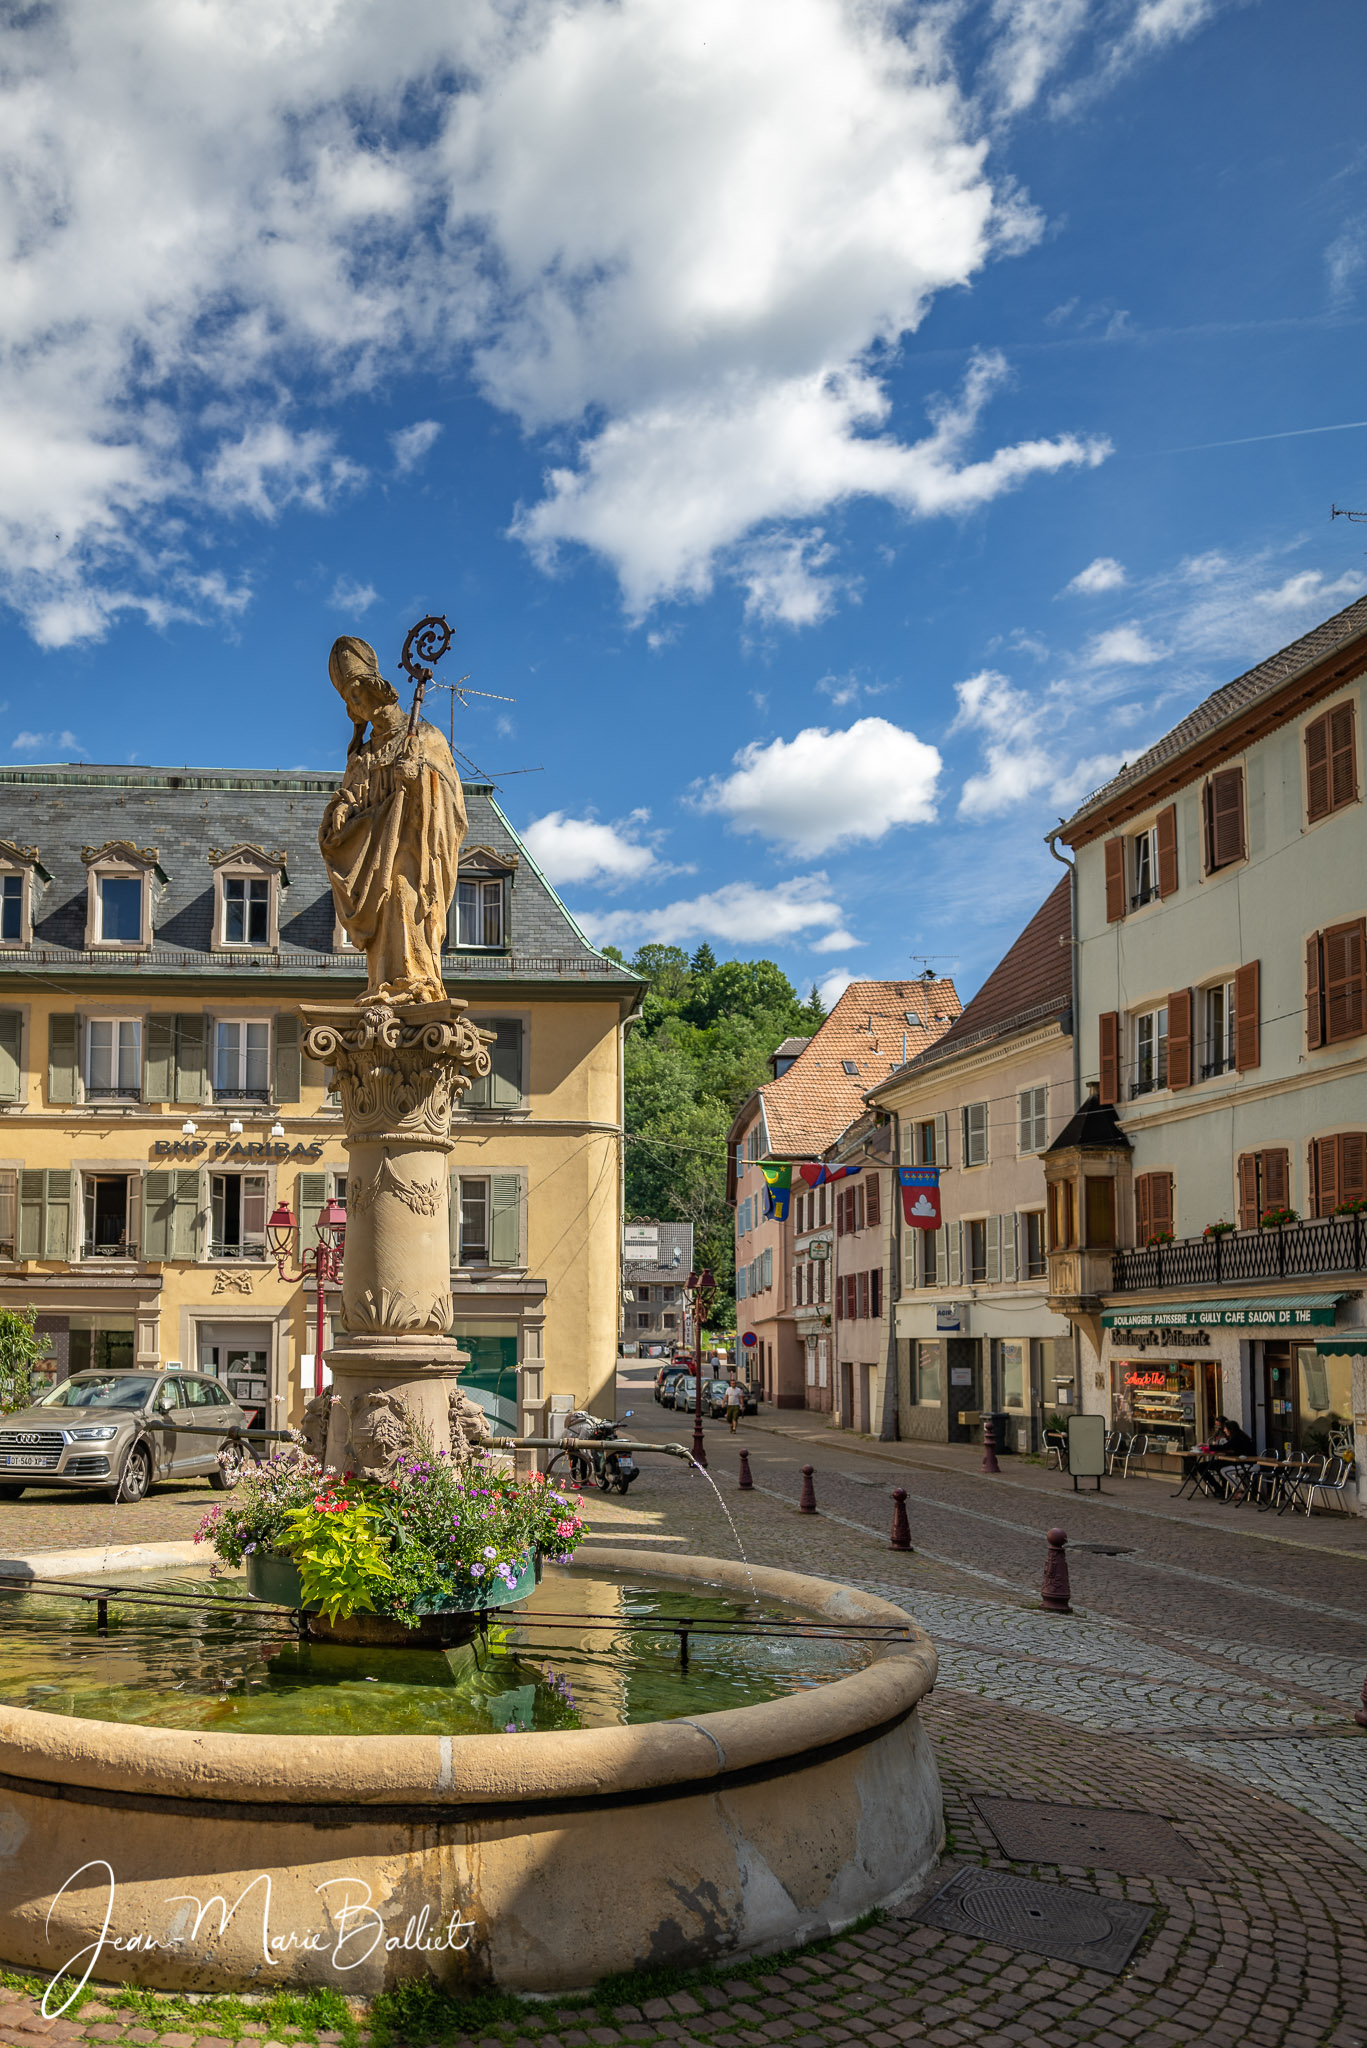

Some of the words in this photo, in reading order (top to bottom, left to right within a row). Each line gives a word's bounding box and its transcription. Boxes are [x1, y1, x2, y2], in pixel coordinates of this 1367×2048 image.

[154, 1140, 208, 1156] BNP
[214, 1141, 324, 1158] PARIBAS
[1113, 1315, 1153, 1326] BOULANGERIE
[1154, 1313, 1188, 1325] PATISSERIE
[1199, 1312, 1221, 1323] GULLY
[1225, 1311, 1246, 1323] CAFE
[1248, 1311, 1276, 1323] SALON
[1279, 1310, 1291, 1323] DE
[1295, 1309, 1311, 1322] THE
[1111, 1328, 1159, 1351] Boulangerie
